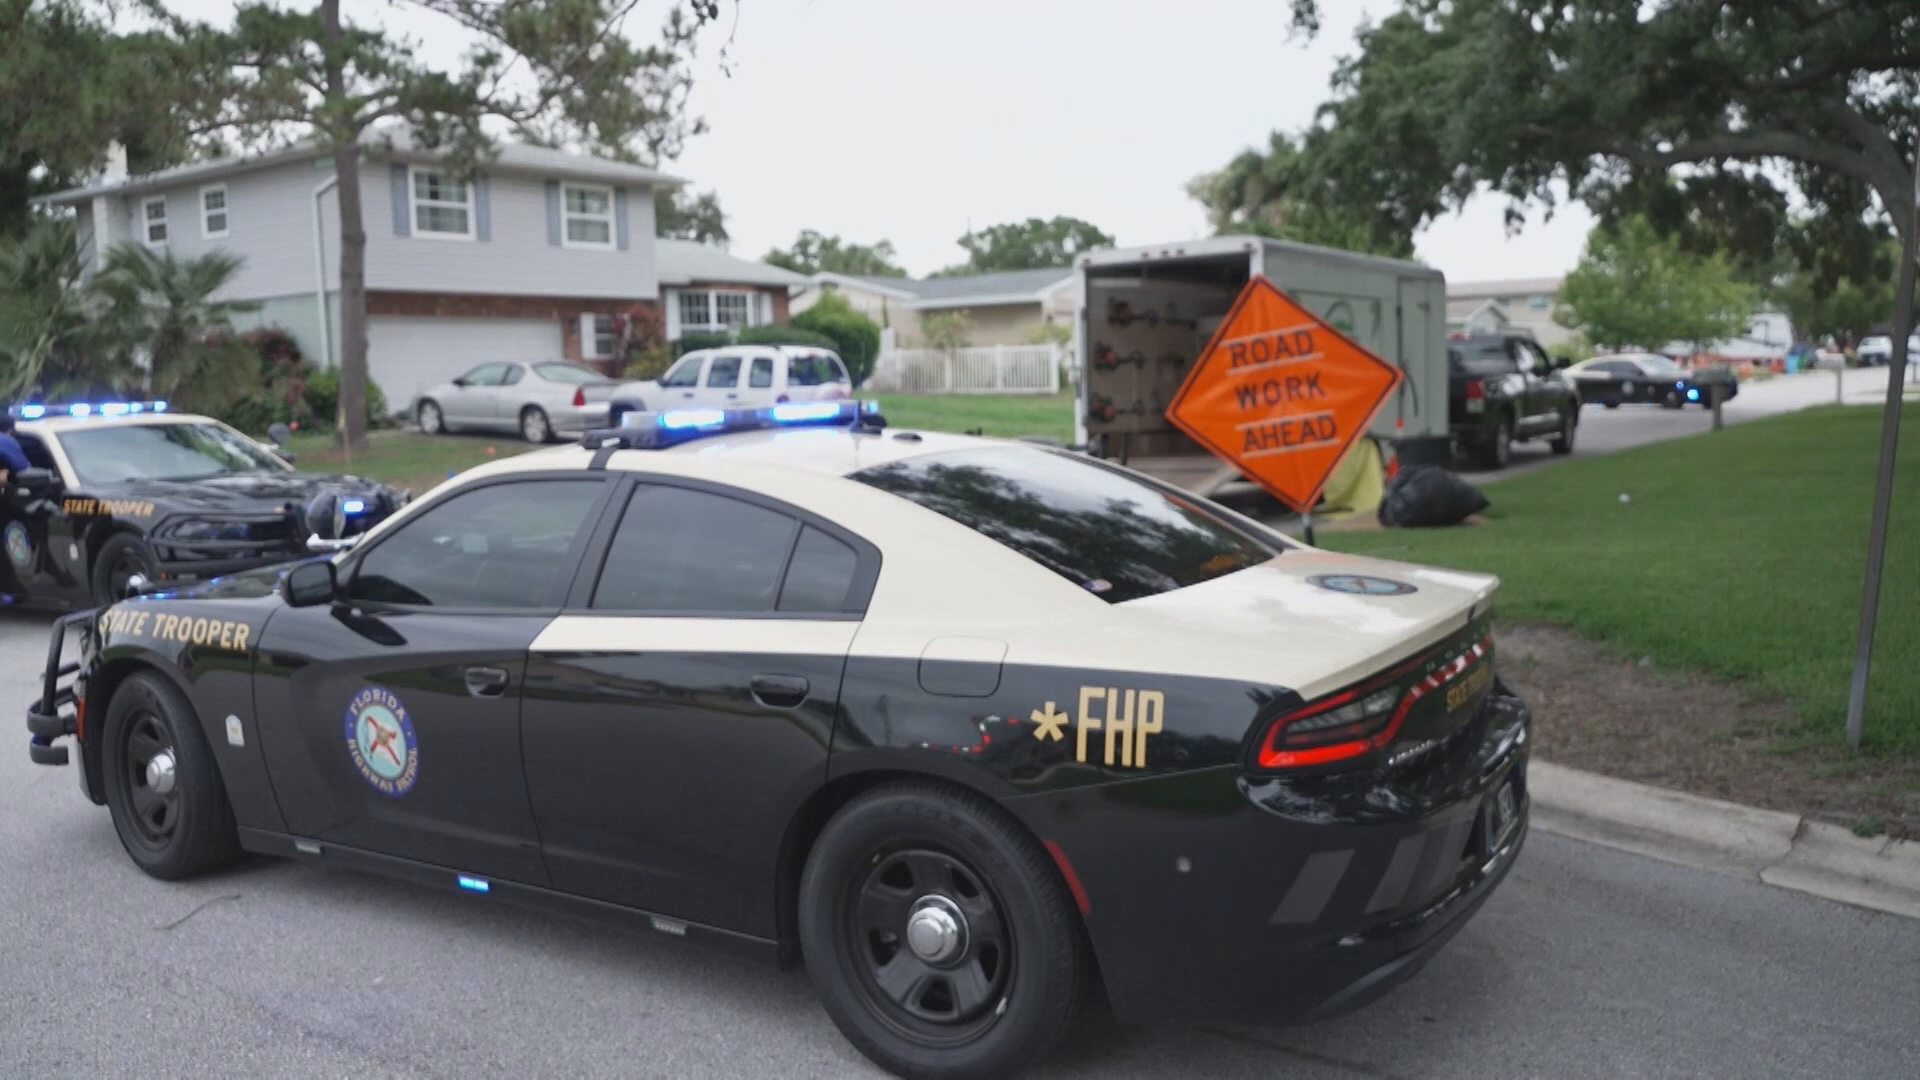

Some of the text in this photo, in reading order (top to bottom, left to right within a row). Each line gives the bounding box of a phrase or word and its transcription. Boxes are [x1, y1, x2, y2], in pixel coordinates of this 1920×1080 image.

[1229, 330, 1313, 367] ROAD
[1235, 372, 1325, 409] WORK
[1243, 414, 1337, 451] AHEAD
[63, 499, 154, 516] STATE TROOPER
[99, 609, 250, 650] STATE TROOPER
[350, 688, 405, 720] FLORIDA
